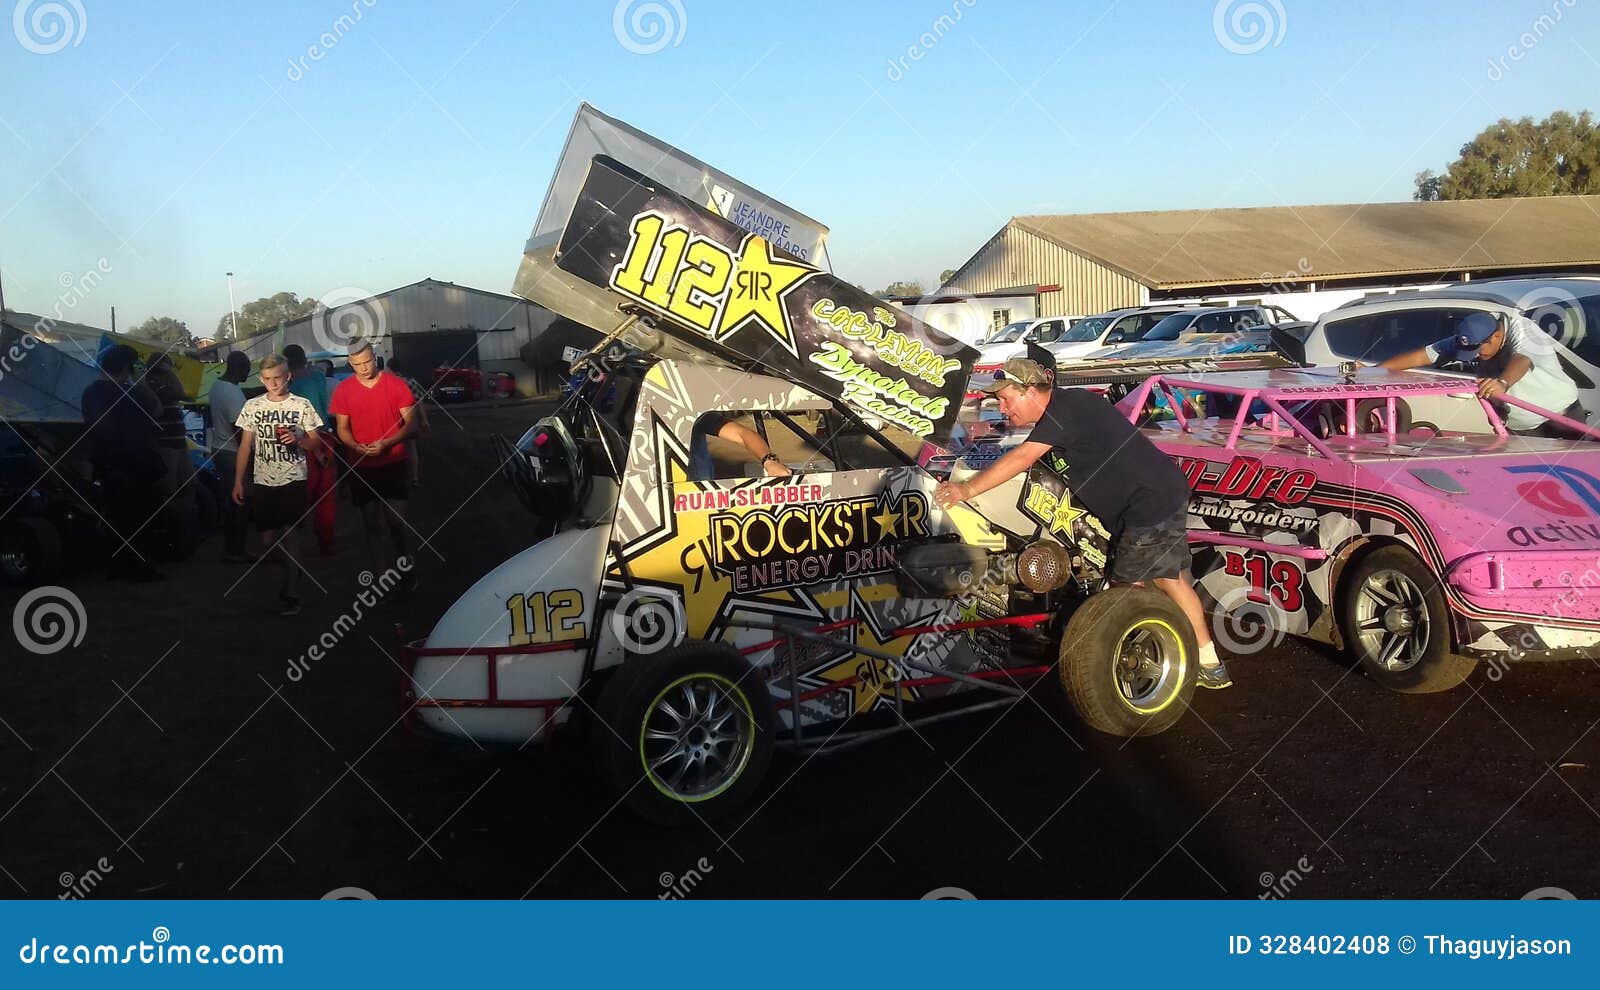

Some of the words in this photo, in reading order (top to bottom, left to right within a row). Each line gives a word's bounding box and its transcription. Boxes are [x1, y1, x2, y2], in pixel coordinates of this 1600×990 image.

[733, 201, 791, 239] JEANDRE
[611, 211, 734, 335] 112
[809, 341, 950, 420] Dynotech
[254, 410, 300, 424] SHAKE
[675, 490, 730, 512] RUAN
[737, 484, 822, 507] SLABBER
[1187, 500, 1319, 531] Embroidery
[734, 554, 832, 591] ENERGY
[845, 546, 900, 574] DRIN
[506, 588, 587, 646] 112
